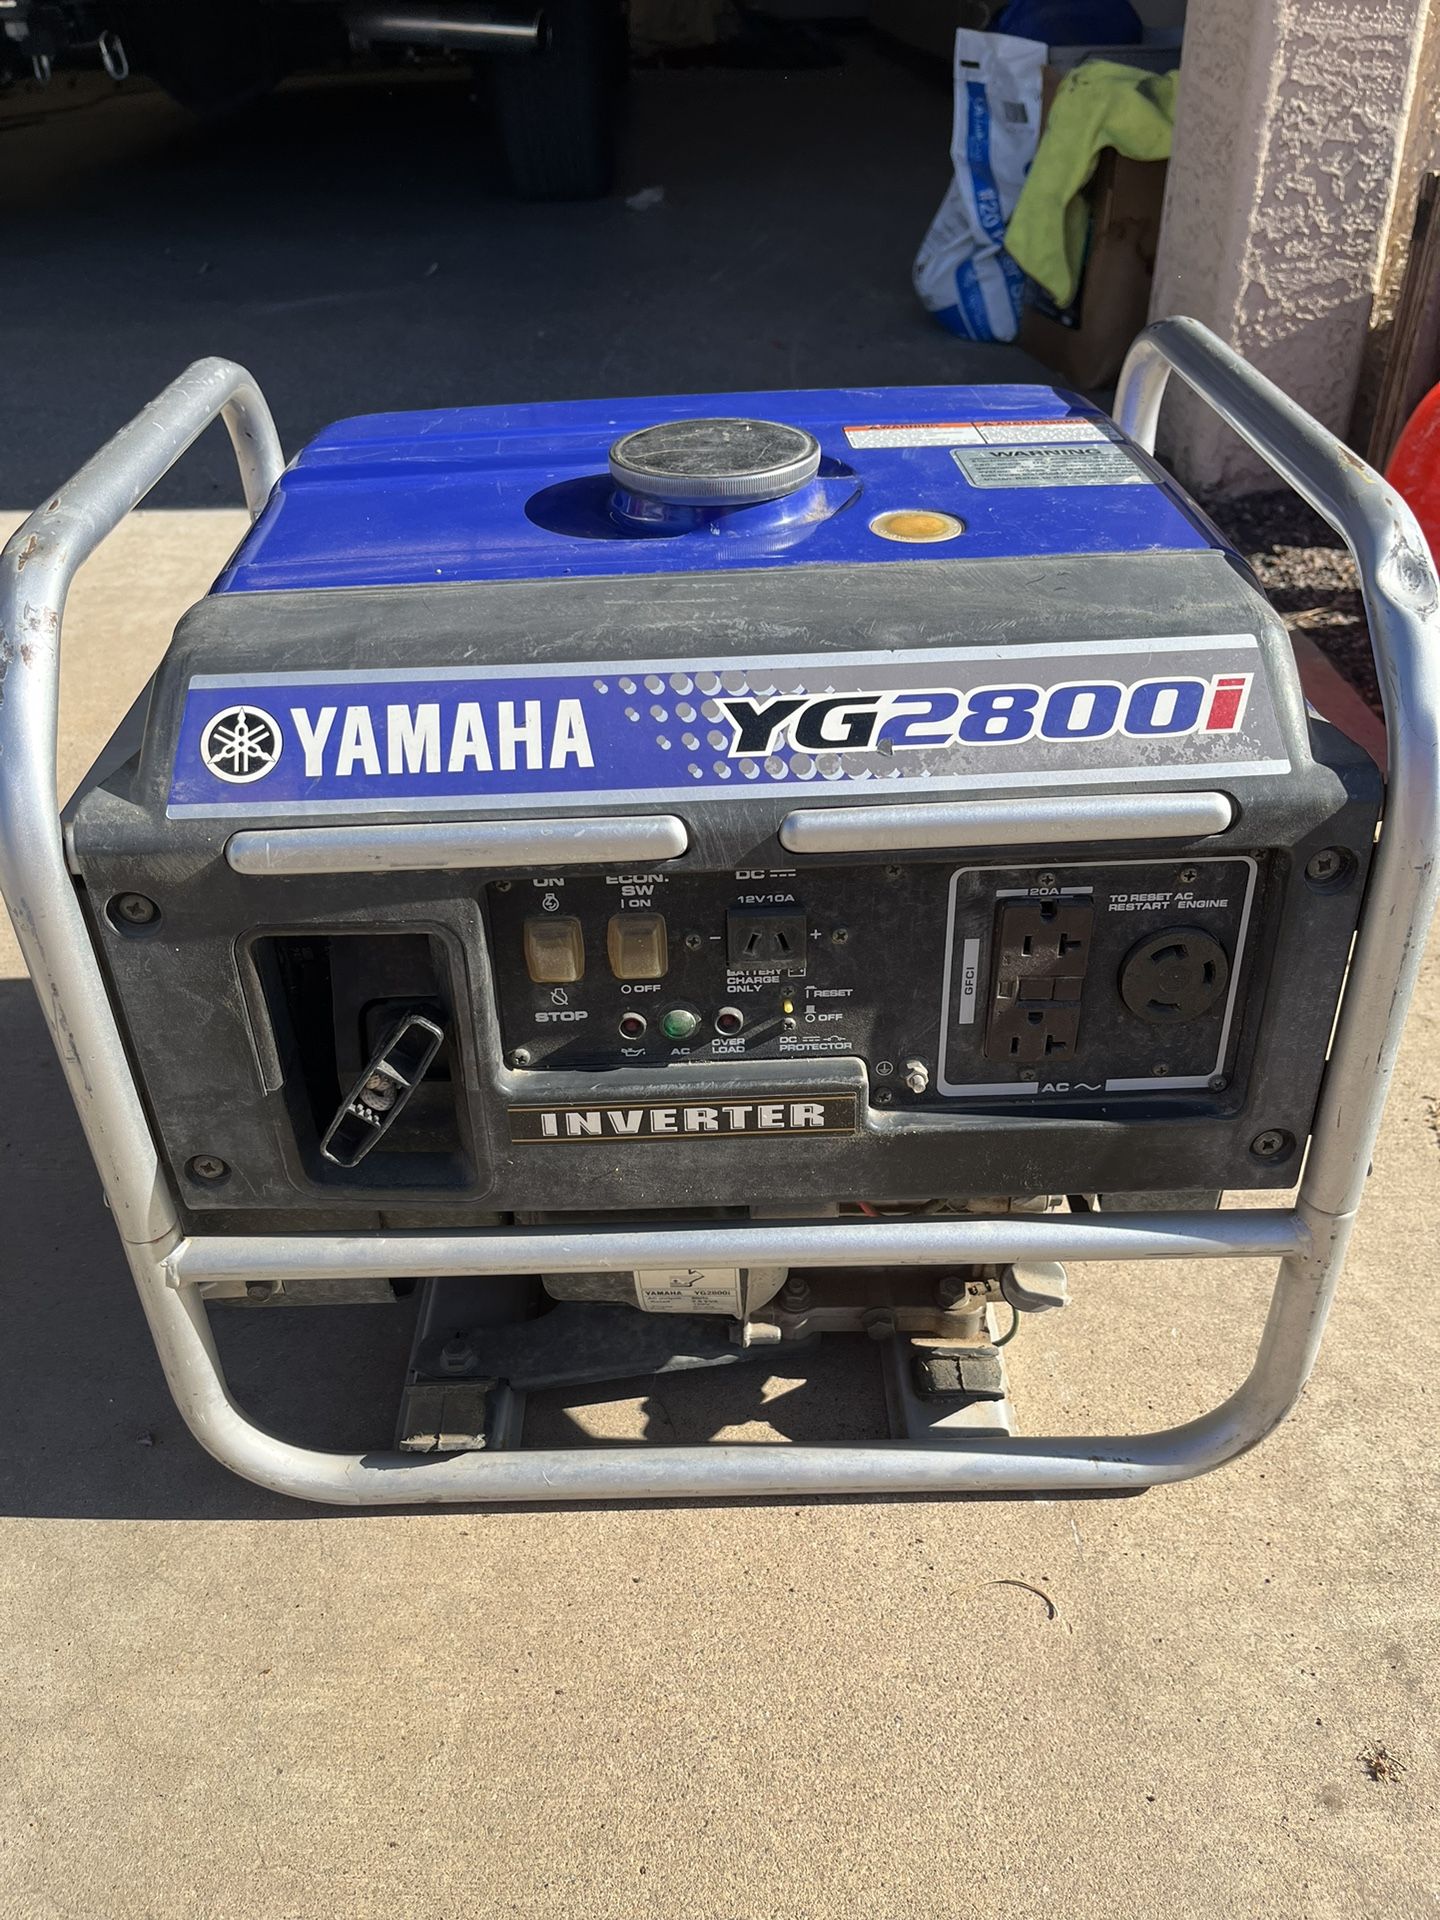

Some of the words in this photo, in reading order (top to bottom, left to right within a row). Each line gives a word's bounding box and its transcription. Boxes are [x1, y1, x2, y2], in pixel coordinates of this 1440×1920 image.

[989, 448, 1101, 457] WARNING
[290, 698, 595, 777] YAMAHA
[713, 671, 1254, 758] YG2800i
[735, 869, 765, 880] DC
[621, 885, 655, 896] SW
[1029, 886, 1059, 896] 20A
[737, 894, 795, 904] 12V10A
[1109, 894, 1128, 903] TO
[1129, 892, 1173, 902] RESET
[1174, 891, 1193, 901] AC
[629, 898, 652, 908] ON
[1108, 901, 1170, 912] RESTART
[1177, 899, 1229, 909] ENGINE
[726, 975, 780, 984] CHARGE
[964, 966, 976, 996] GFCI
[634, 984, 662, 993] OFF
[726, 984, 763, 993] ONLY
[813, 988, 854, 998] RESET
[535, 1010, 589, 1023] STOP
[818, 1013, 844, 1022] OFF
[711, 1037, 746, 1047] OVER
[779, 1035, 798, 1044] DC
[670, 1047, 691, 1056] AC
[711, 1045, 746, 1055] LOAD
[779, 1042, 853, 1052] PROTECTOR
[1042, 1081, 1070, 1093] AC
[540, 1102, 826, 1138] INVERTER
